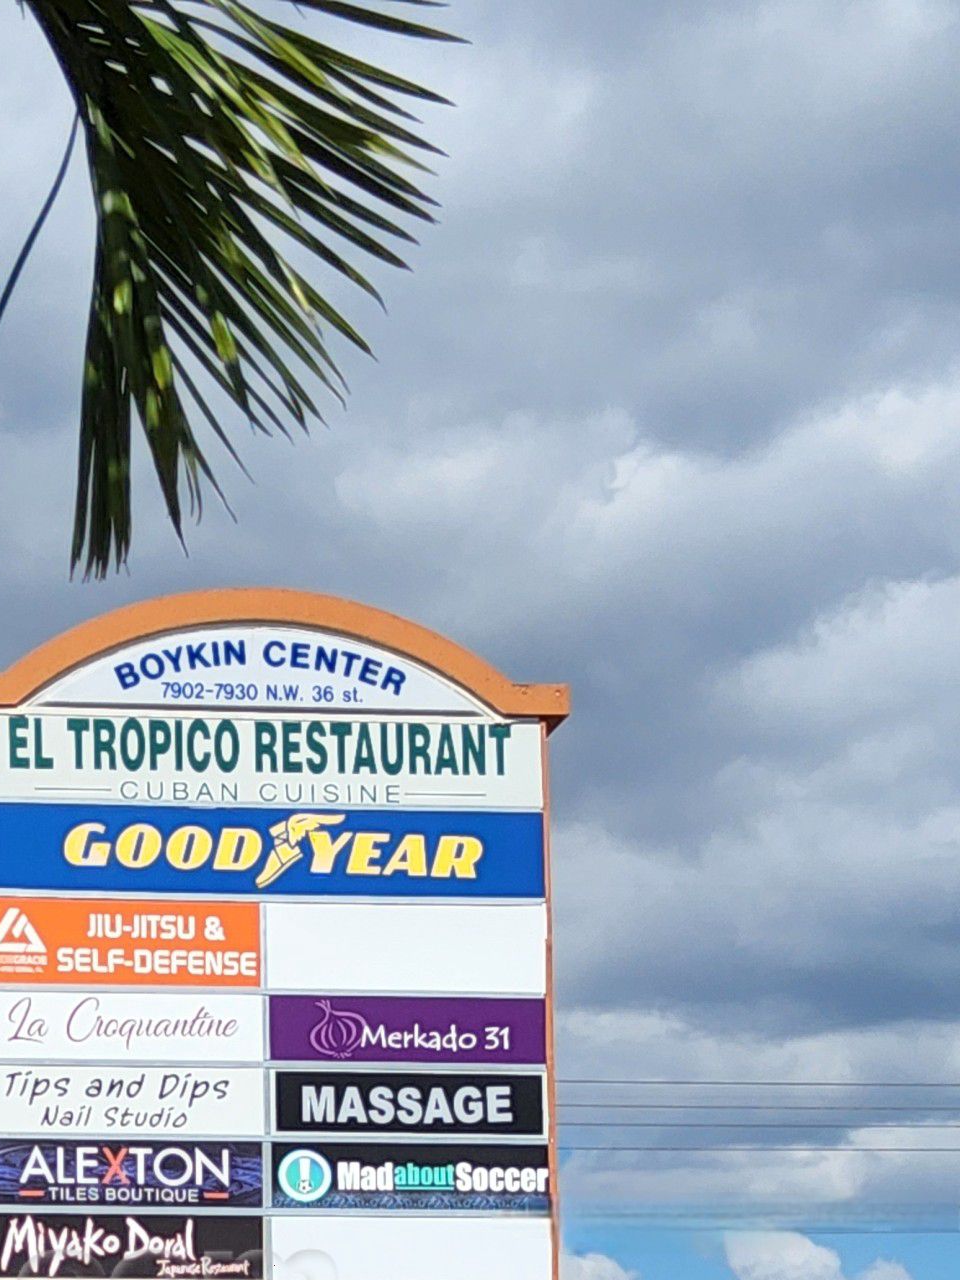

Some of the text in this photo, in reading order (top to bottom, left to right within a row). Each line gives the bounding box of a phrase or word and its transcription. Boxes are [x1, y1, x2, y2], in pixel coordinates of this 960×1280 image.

[114, 640, 407, 695] BOYKIN CENTER
[161, 682, 364, 703] 7902-7930 N.W. 36 st.
[8, 717, 512, 777] EL TROPICO RESTAURANT
[120, 780, 402, 804] CUBAN CUISINE
[87, 913, 226, 941] JIU-JITSU &
[56, 947, 257, 977] SELF-DEFENSE
[8, 996, 238, 1050] La Croquantine
[361, 1023, 511, 1052] Merkado 31
[5, 1071, 230, 1108] Tips and Dips
[301, 1085, 514, 1125] MASSAGE
[40, 1106, 187, 1129] Nail Studio
[19, 1146, 230, 1186] ALEXTON
[49, 1187, 200, 1204] TILES BOUTIQUE
[0, 1214, 196, 1279] Miyako Doral
